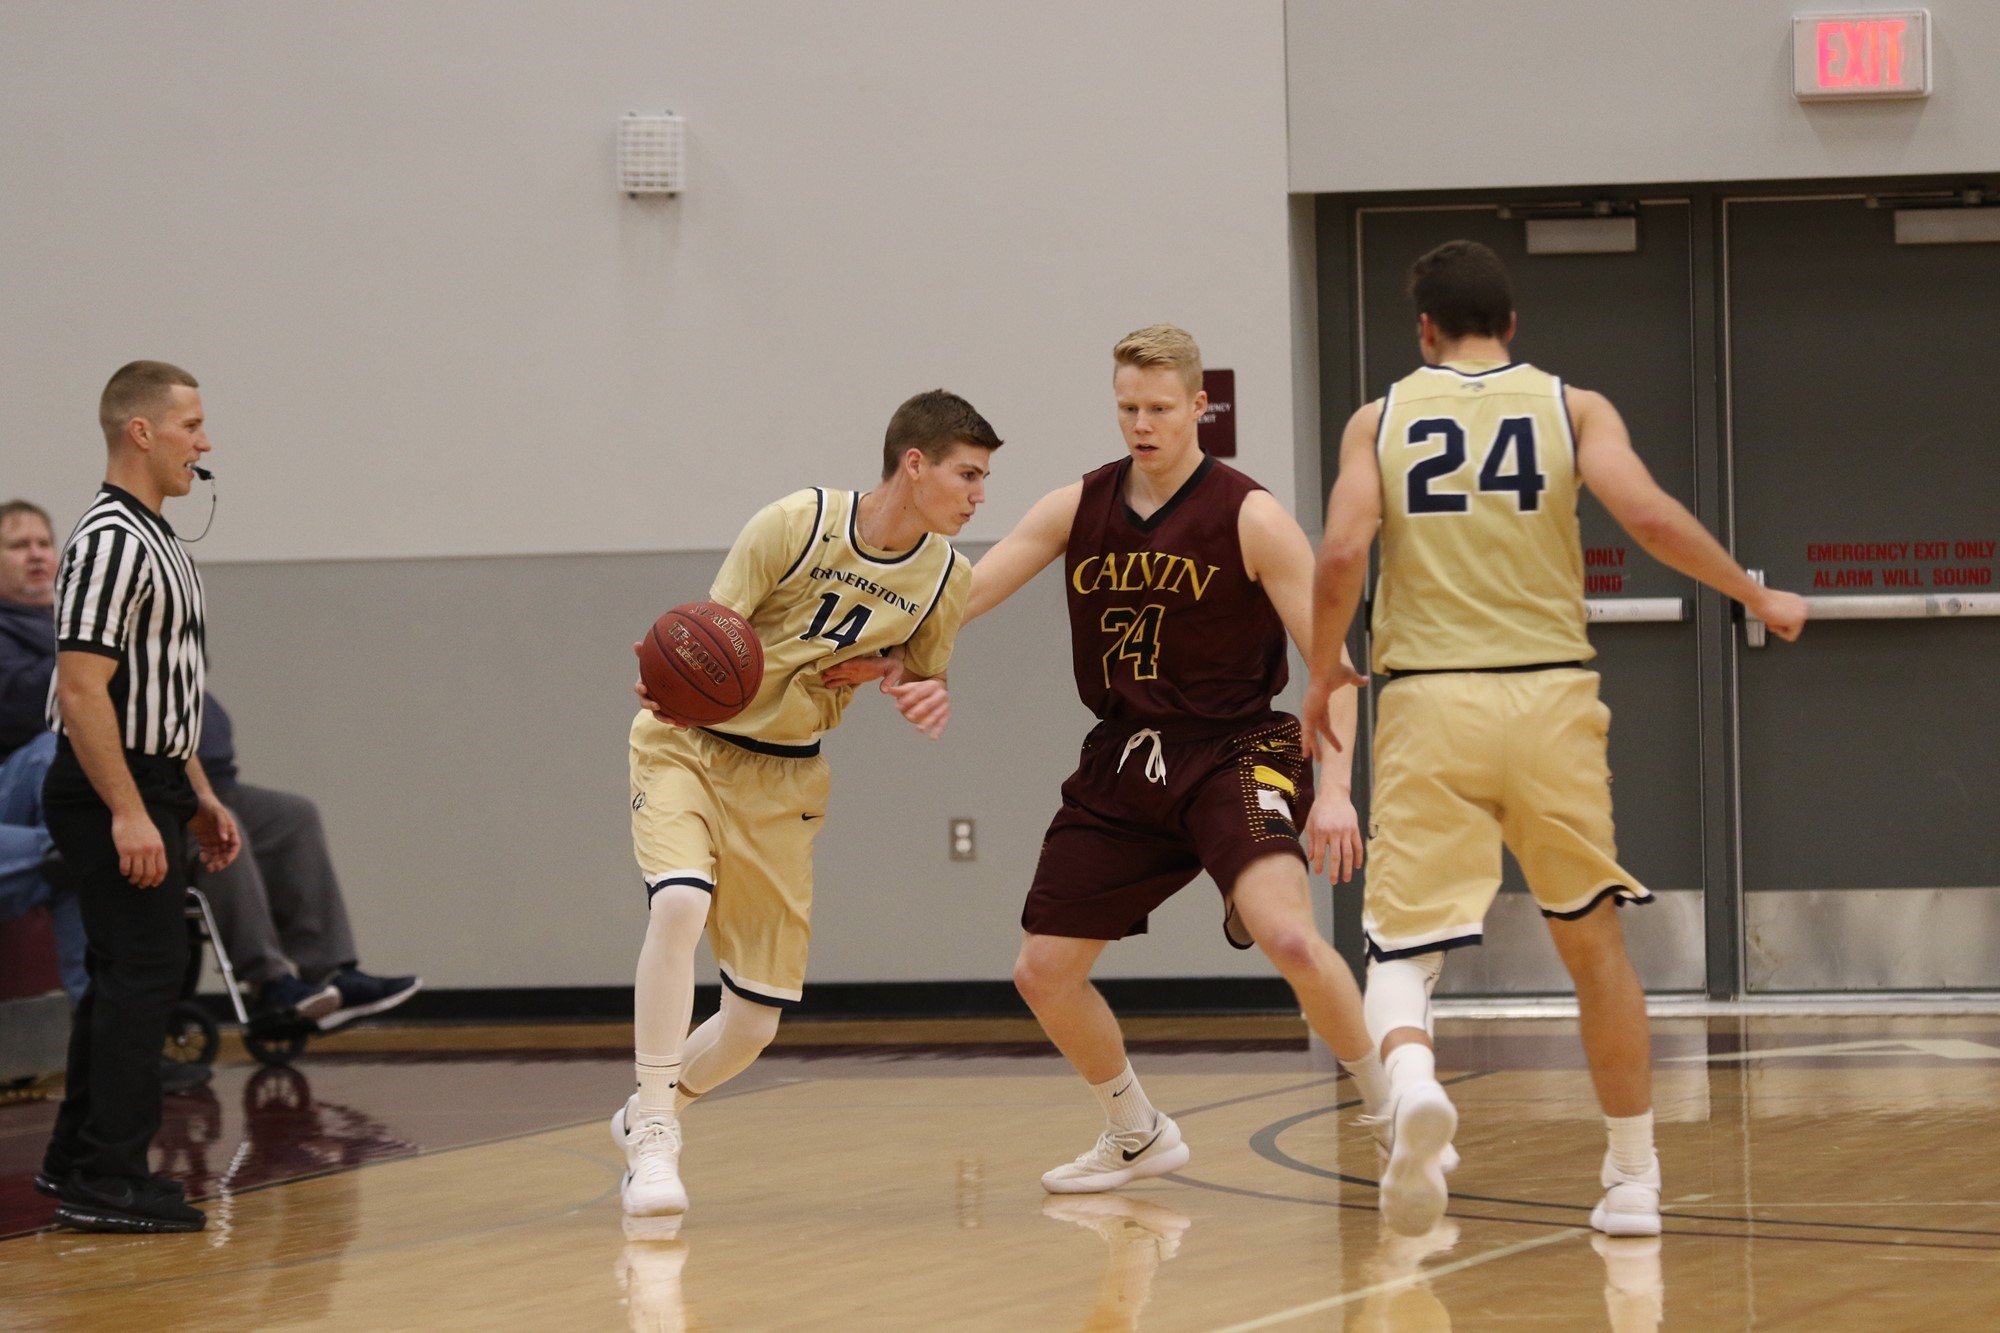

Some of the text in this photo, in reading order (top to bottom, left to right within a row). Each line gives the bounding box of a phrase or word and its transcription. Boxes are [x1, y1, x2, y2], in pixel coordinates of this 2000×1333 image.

[1817, 20, 1906, 87] EXIT
[1405, 415, 1546, 516] 24
[1072, 551, 1221, 601] CALVIN
[1585, 547, 1626, 567] ONLY
[1807, 540, 1997, 562] EMERGENCY EXIT ONLY
[1813, 567, 1992, 588] ALARM WILL SOUND
[1584, 573, 1623, 593] UND
[668, 621, 727, 684] TF-1000
[688, 605, 754, 670] SPALDING
[798, 591, 873, 655] 14
[1100, 603, 1166, 689] 24
